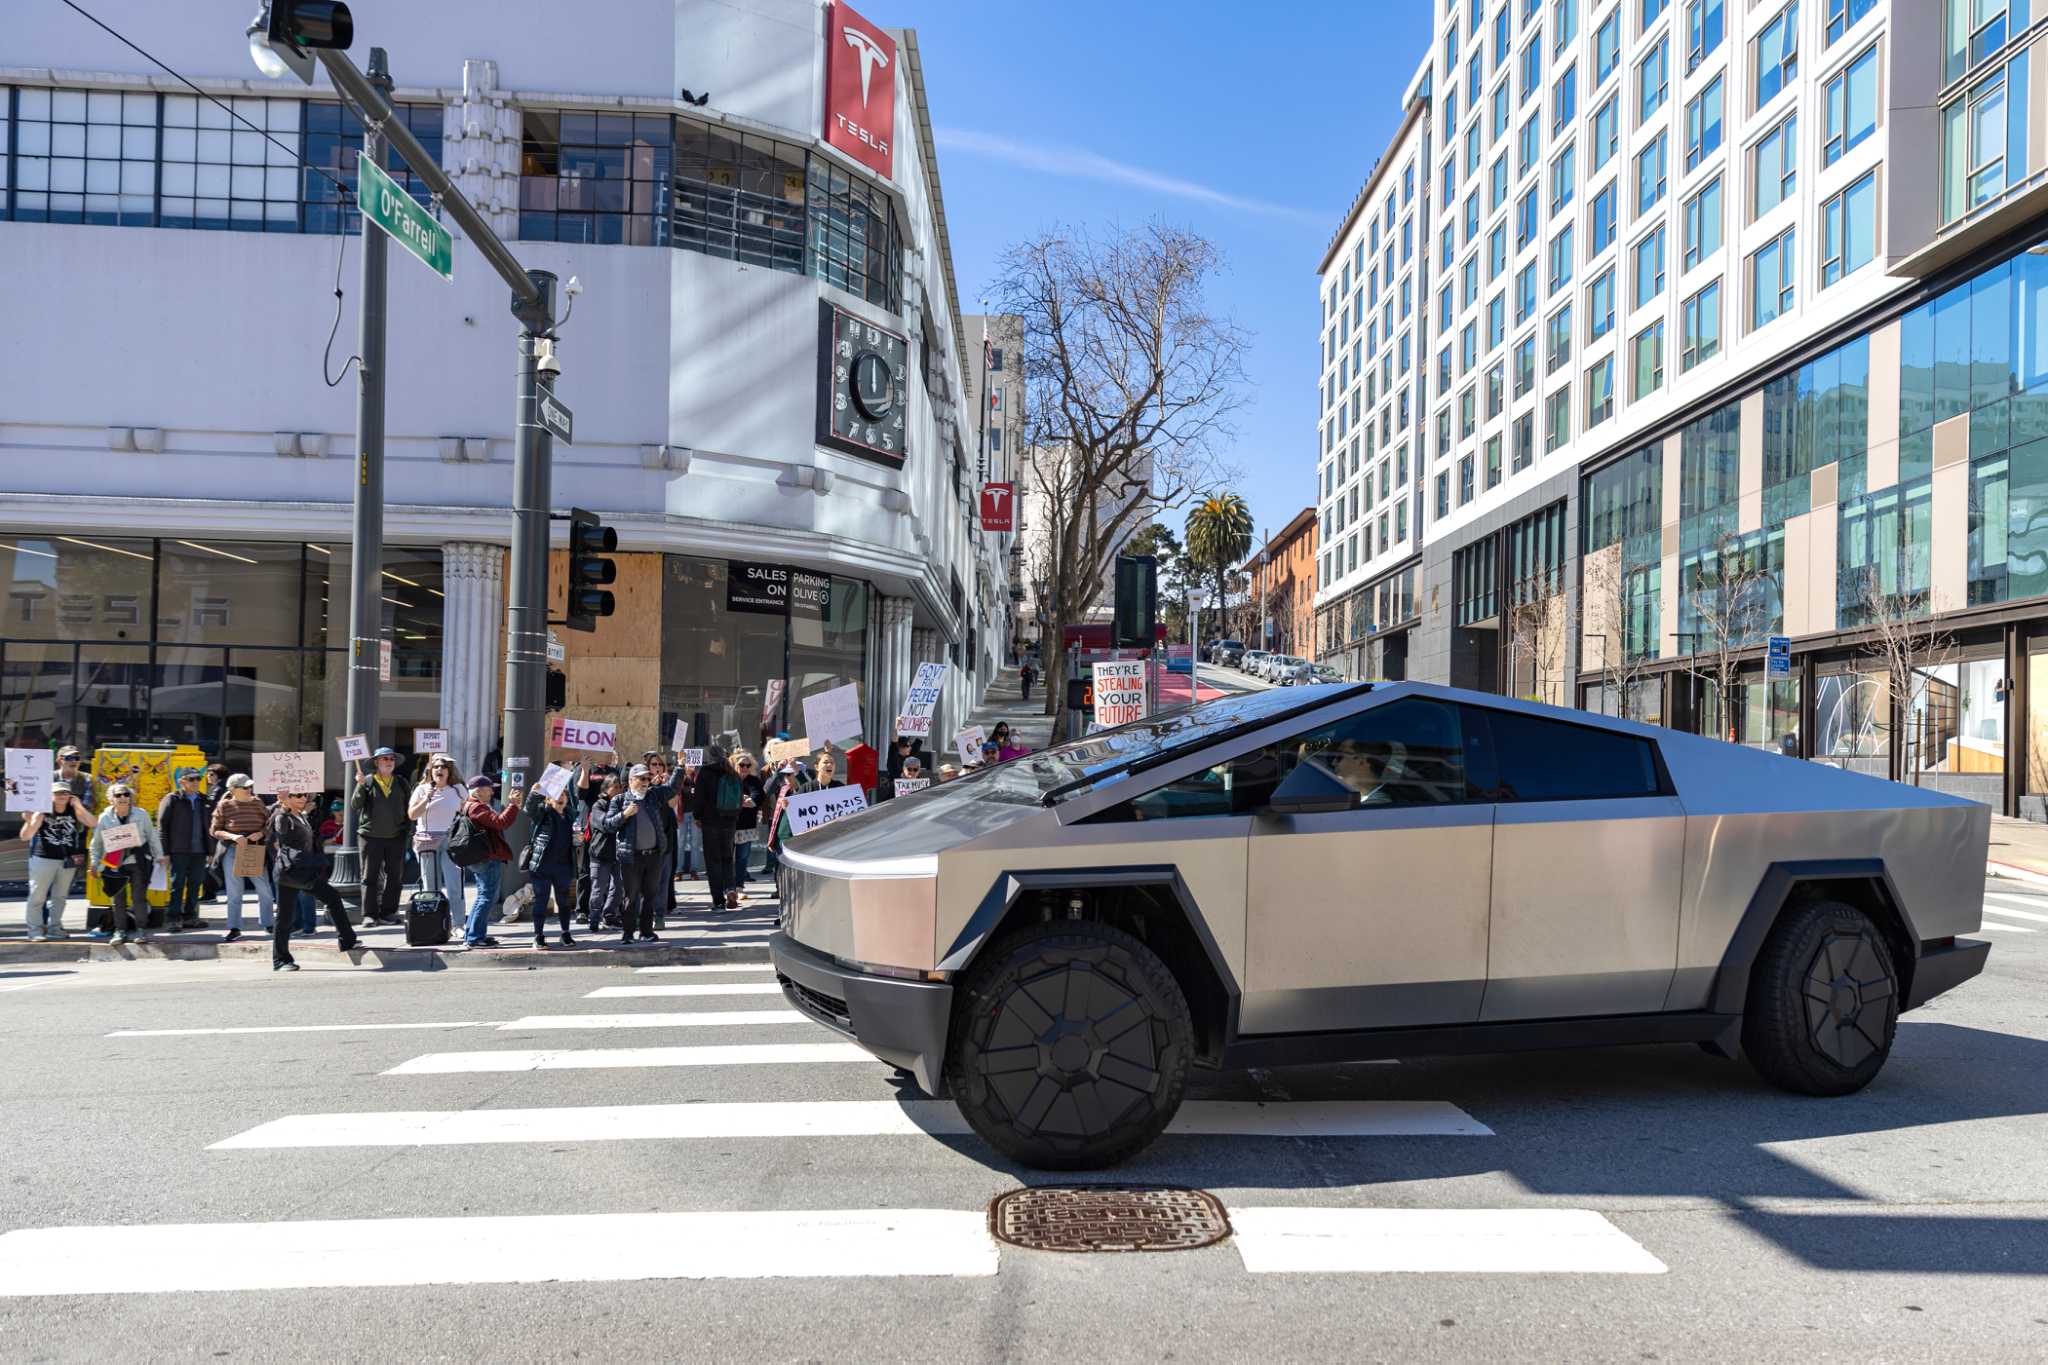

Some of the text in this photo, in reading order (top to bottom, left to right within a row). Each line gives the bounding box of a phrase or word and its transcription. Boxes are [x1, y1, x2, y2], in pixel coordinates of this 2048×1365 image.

[836, 113, 888, 156] TESLA
[381, 188, 436, 257] O'Farrell
[881, 432, 894, 450] 5
[747, 567, 830, 589] SALES PARKING
[766, 584, 818, 601] ON OLIVE
[731, 596, 785, 606] SERVICE ENTRANCE
[1097, 664, 1140, 676] THEY'RE
[921, 679, 935, 687] FOR
[1097, 677, 1143, 692] STEALING
[909, 688, 939, 703] PEOPLE
[1098, 693, 1142, 705] YOUR
[907, 703, 928, 716] NOT
[1098, 704, 1142, 724] FUTURE
[552, 726, 616, 748] FELON
[273, 752, 302, 761] USA
[798, 796, 862, 818] NO NAZIS
[806, 819, 818, 829] IN
